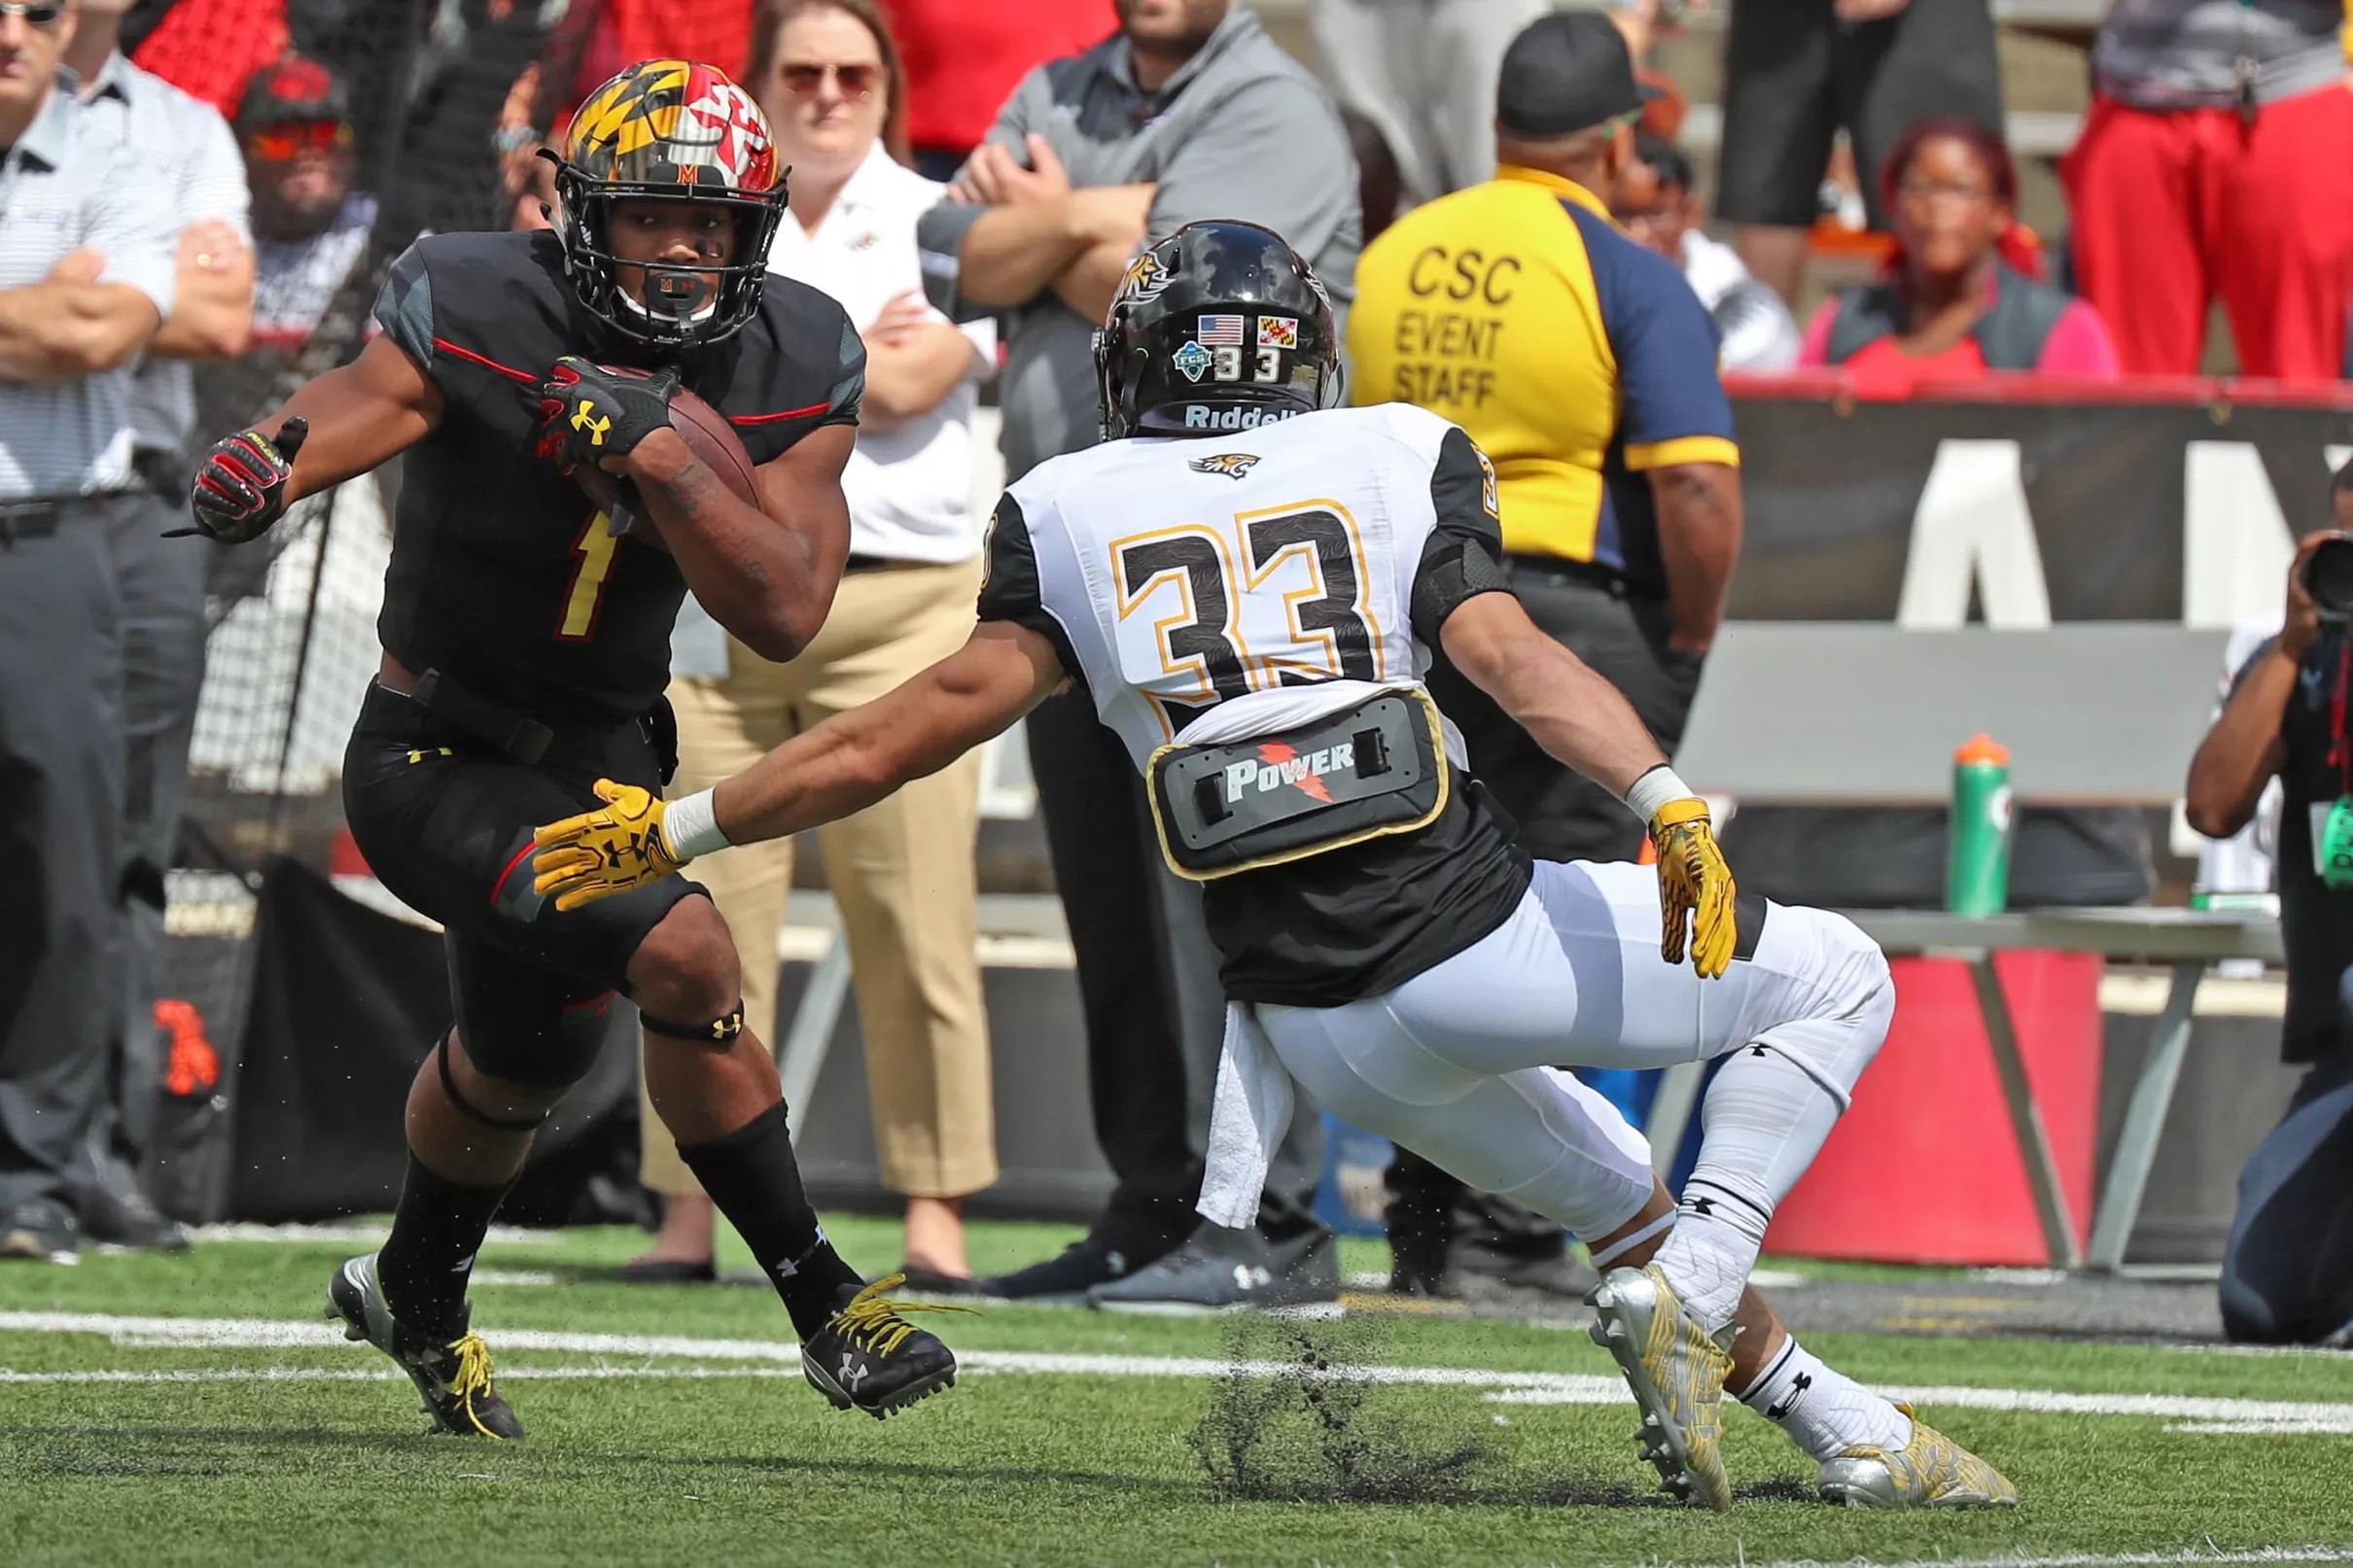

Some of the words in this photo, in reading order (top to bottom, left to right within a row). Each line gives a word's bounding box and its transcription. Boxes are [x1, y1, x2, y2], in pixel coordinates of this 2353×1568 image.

[677, 163, 700, 185] M
[1409, 246, 1522, 305] CSC
[1396, 311, 1503, 360] EVENT
[1393, 364, 1495, 407] STAFF
[553, 505, 621, 642] 1
[1109, 498, 1385, 744] 33
